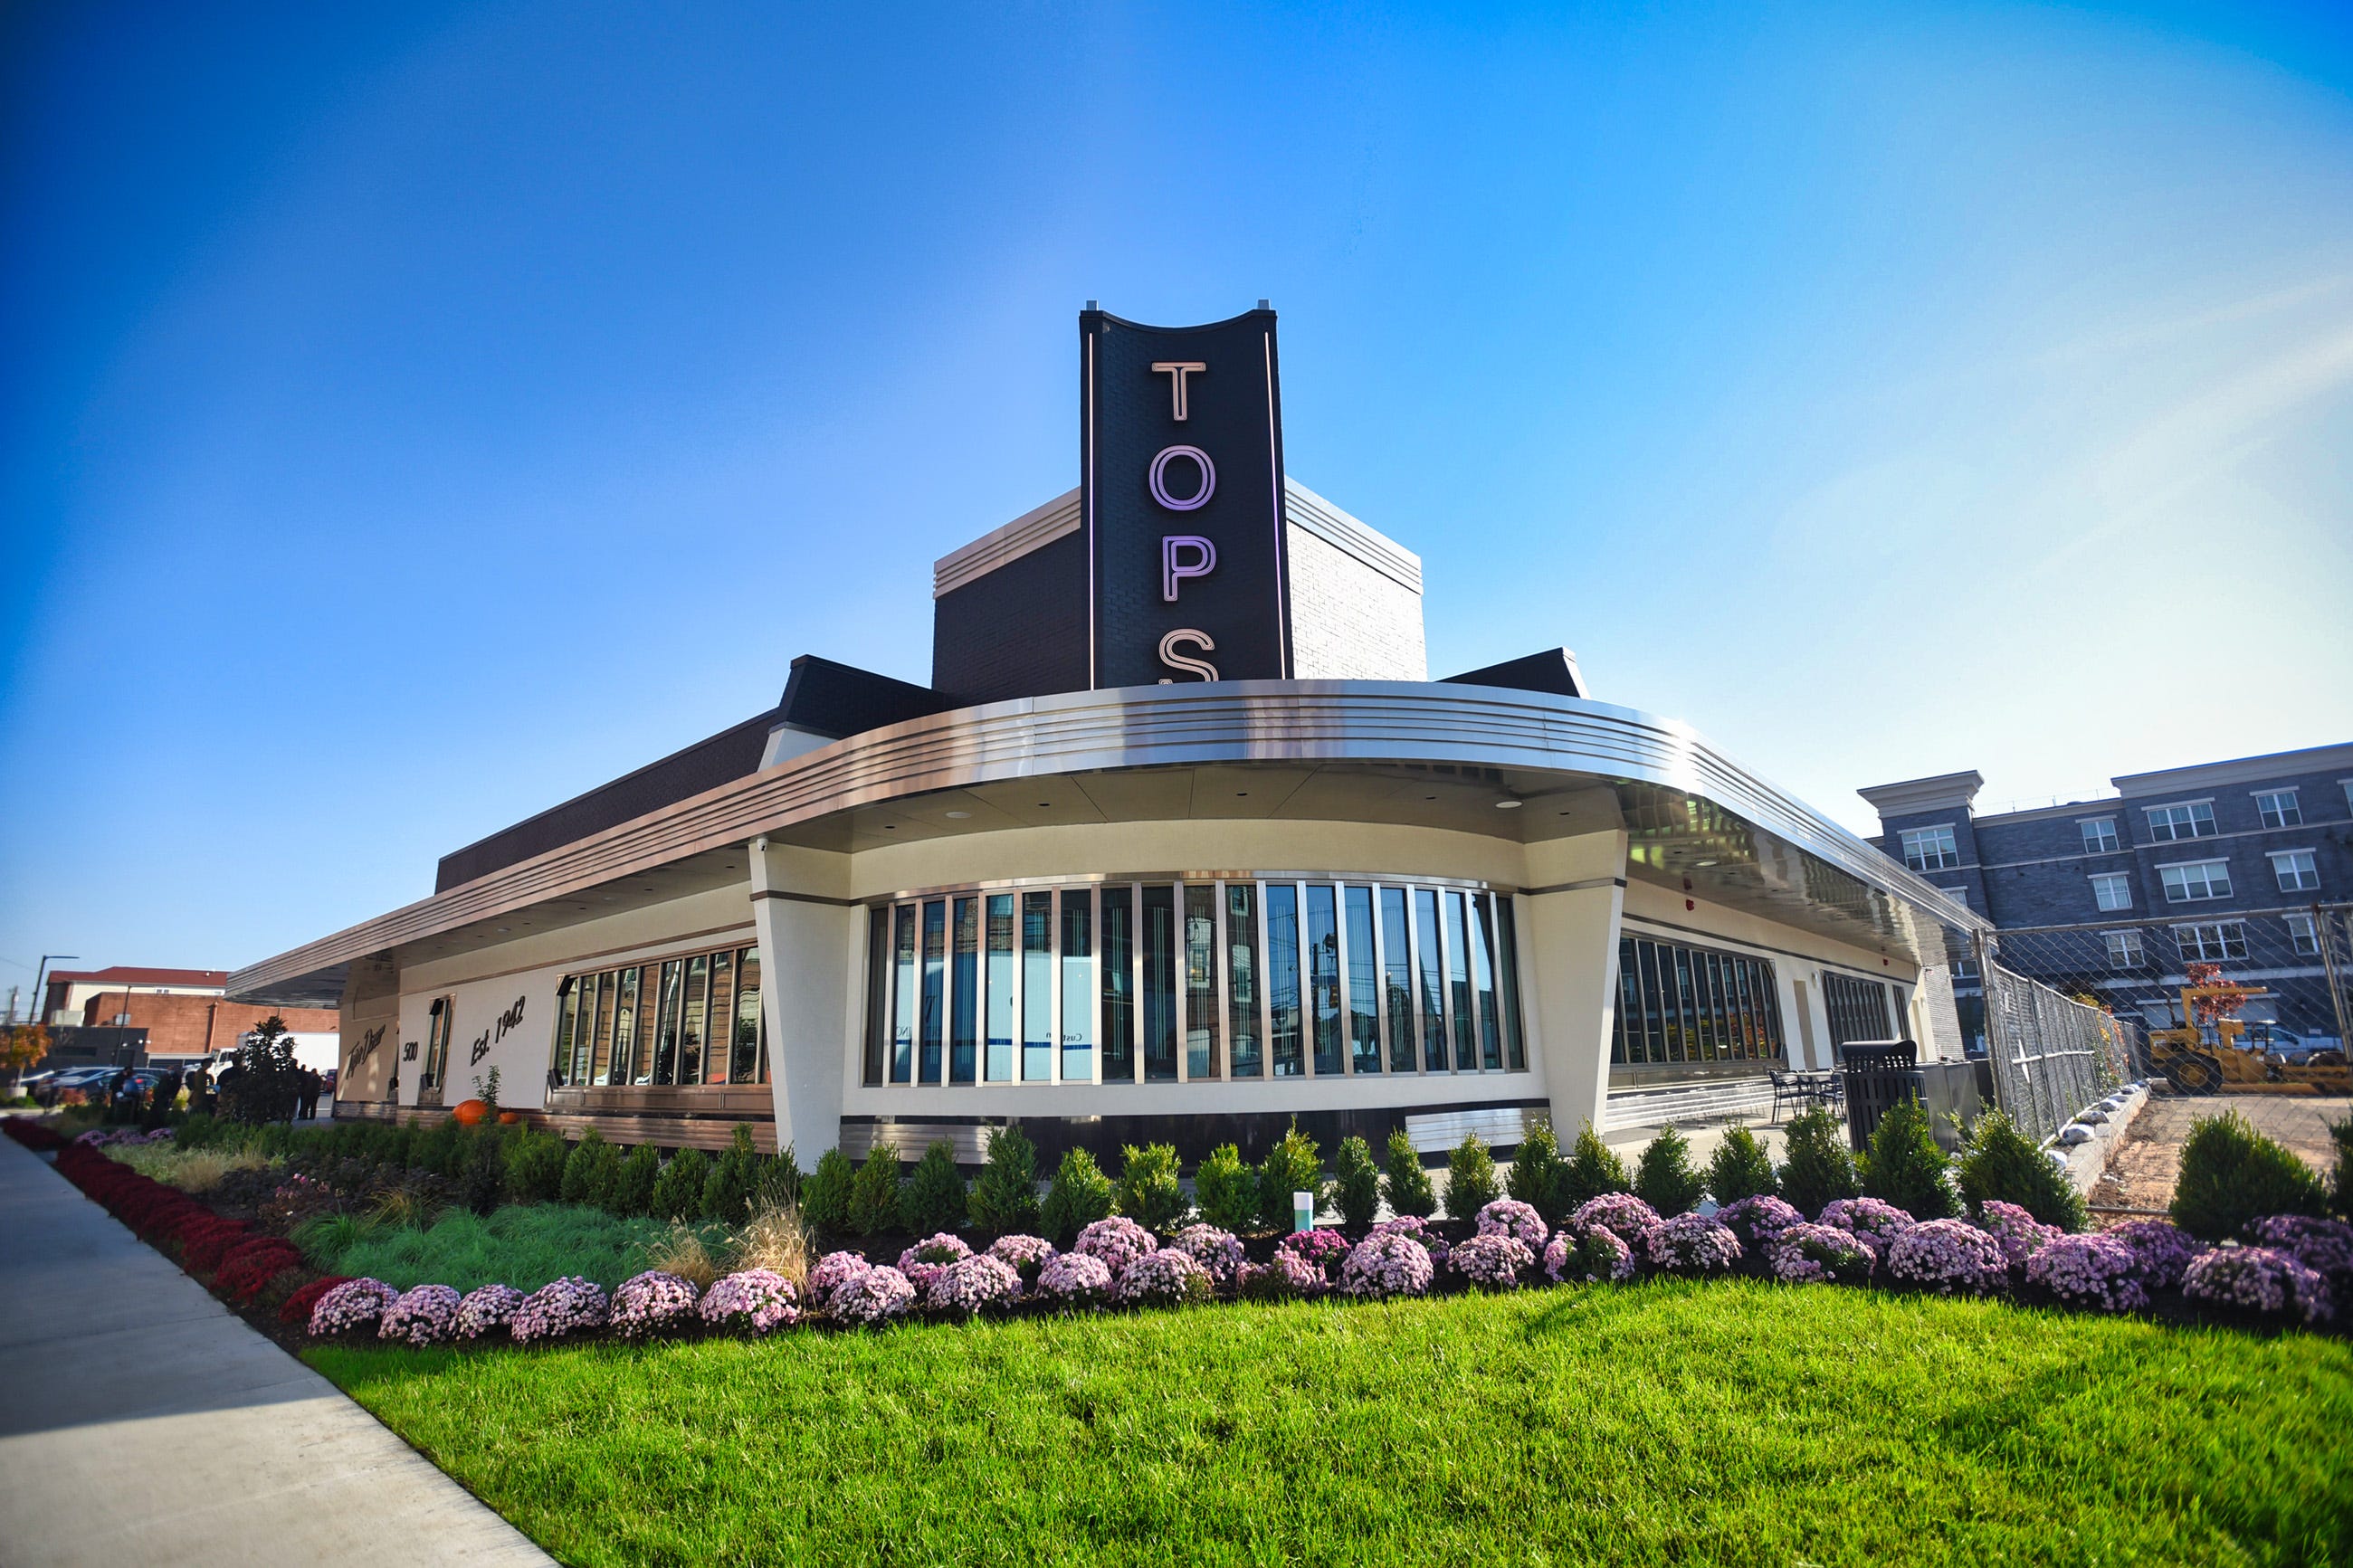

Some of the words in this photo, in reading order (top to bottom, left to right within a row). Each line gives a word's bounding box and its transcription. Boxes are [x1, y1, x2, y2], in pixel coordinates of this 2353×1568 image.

[1148, 362, 1219, 685] TOPS
[403, 1041, 419, 1062] 500
[471, 1028, 491, 1067] Est.
[494, 995, 526, 1043] 1942
